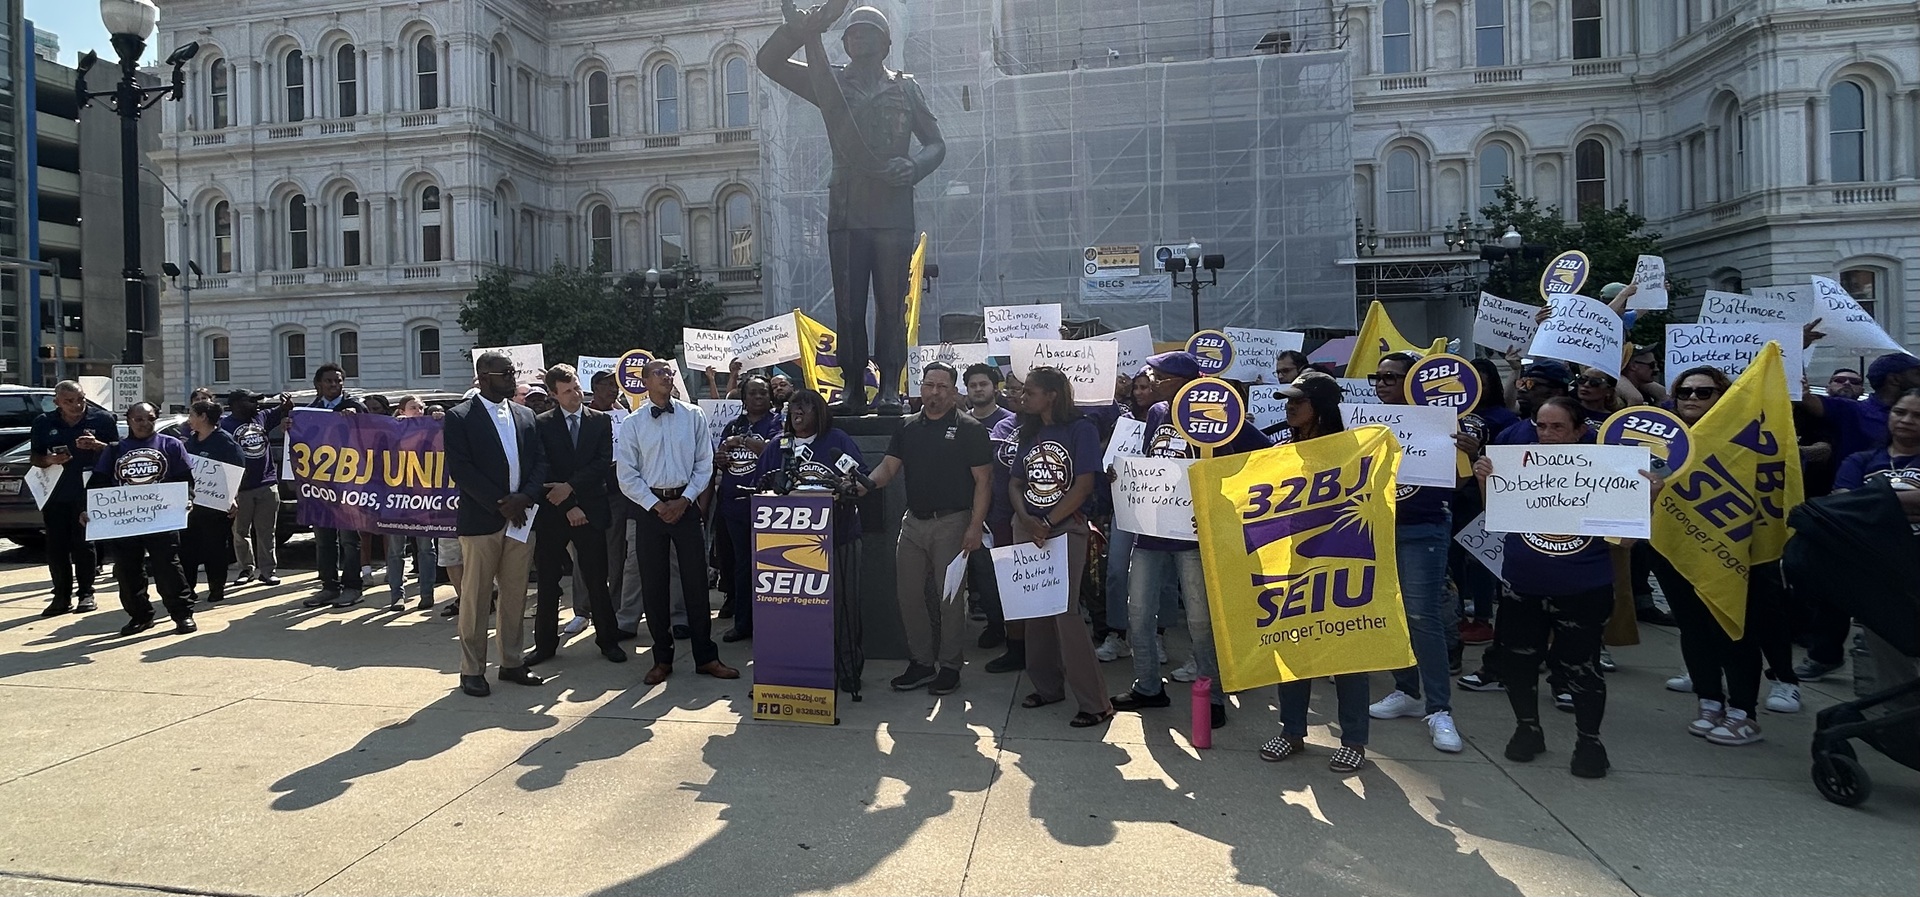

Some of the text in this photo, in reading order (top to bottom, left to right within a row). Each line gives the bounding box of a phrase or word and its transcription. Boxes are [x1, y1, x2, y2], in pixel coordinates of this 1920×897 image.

[1556, 259, 1584, 270] 32BJ
[1098, 280, 1124, 288] BECS
[1546, 282, 1572, 293] SEIU
[1020, 322, 1030, 332] by
[1489, 314, 1515, 328] better
[1544, 320, 1556, 332] Do
[742, 342, 760, 354] better
[1196, 338, 1225, 348] 32BJ
[1034, 343, 1080, 358] Abacus
[1668, 350, 1690, 364] Do
[1692, 350, 1731, 362] better
[1735, 349, 1752, 365] by
[910, 366, 921, 374] Do
[1076, 364, 1087, 372] by
[1419, 362, 1460, 382] 32BJ
[1188, 390, 1230, 402] 32BJ
[1252, 404, 1266, 414] Do
[1350, 406, 1403, 424] Abacus
[1188, 422, 1228, 434] SEIU
[1624, 416, 1680, 439] 32BJ
[1399, 430, 1412, 440] by
[1118, 441, 1128, 452] do
[292, 442, 374, 485] 32BJ
[1523, 450, 1592, 468] Abacus,
[122, 466, 158, 476] POWER
[1123, 460, 1166, 477] Abacus
[1130, 482, 1159, 492] Better
[1165, 482, 1177, 492] by
[1242, 456, 1374, 520] 32BJ
[1490, 472, 1640, 494] Do better by your
[93, 490, 164, 507] Baltimore,
[300, 483, 336, 502] GOOD
[340, 490, 380, 510] JOBS,
[386, 494, 442, 510] STRONG
[1526, 492, 1590, 509] workers!
[91, 504, 170, 520] Do better by your
[754, 506, 830, 530] 32BJ
[1014, 549, 1050, 566] Abacus
[1012, 569, 1022, 582] do
[1026, 568, 1046, 580] better
[755, 572, 830, 596] SEIU
[1023, 582, 1040, 594] your
[756, 594, 830, 606] Stronger Together
[1256, 566, 1376, 628] SEIU
[1258, 615, 1387, 647] Stronger Together
[761, 692, 826, 704] www.seiu32bj.org
[796, 708, 831, 716] @32BJSEIU
